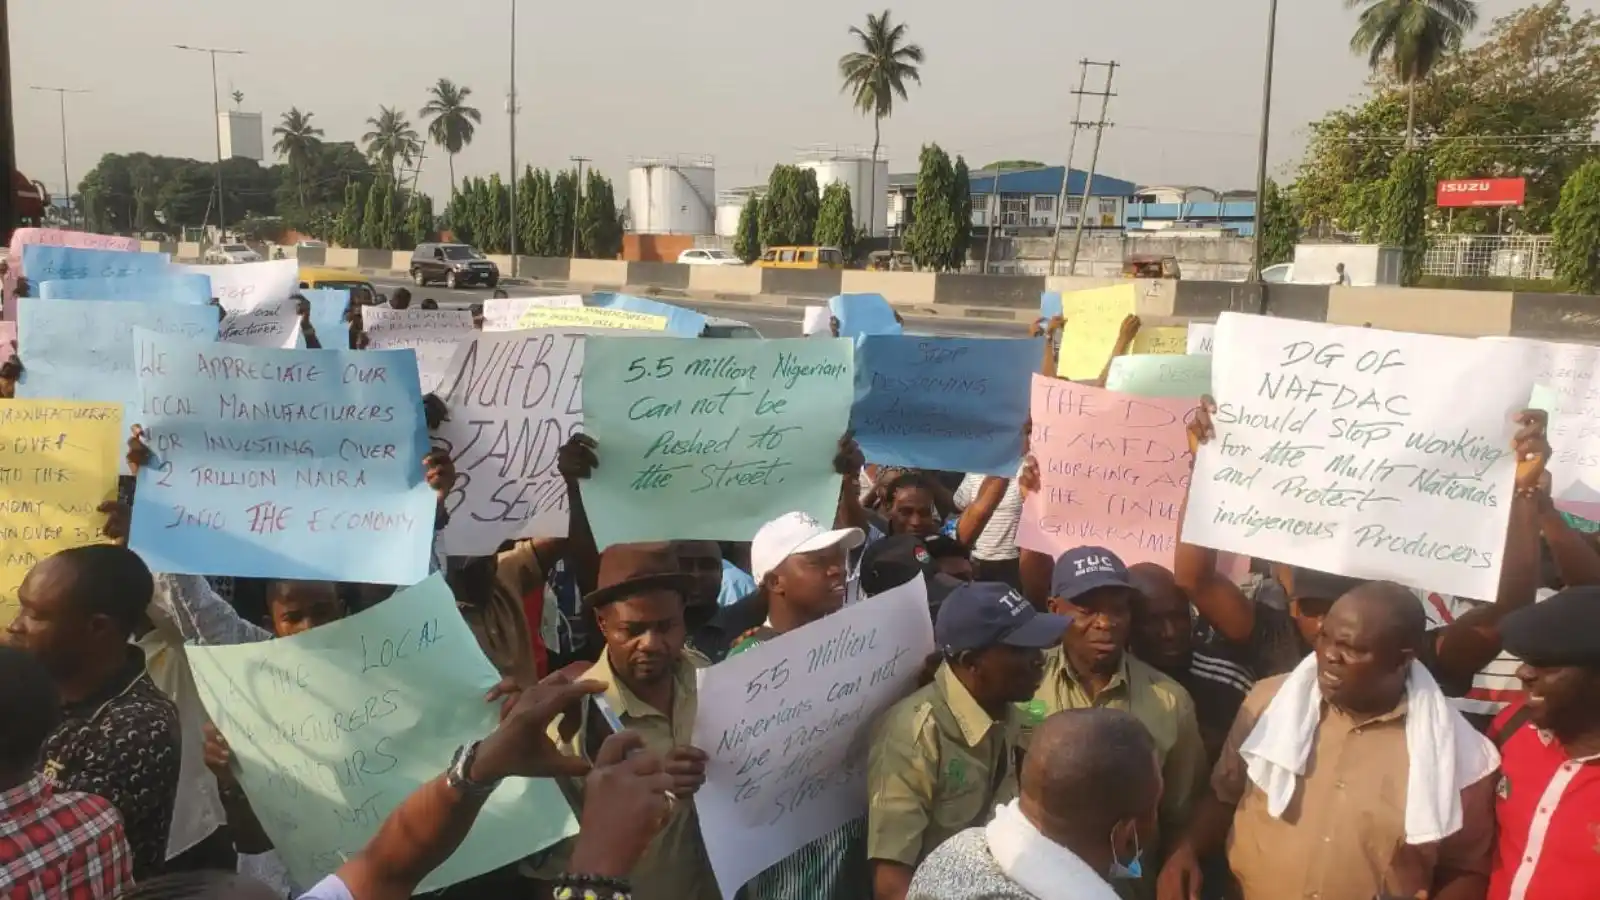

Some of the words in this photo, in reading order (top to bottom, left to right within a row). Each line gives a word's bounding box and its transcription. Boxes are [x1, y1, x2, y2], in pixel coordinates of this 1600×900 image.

[1441, 182, 1490, 192] ISUZU
[140, 341, 167, 379] WE
[342, 363, 387, 385] OUR
[1280, 341, 1346, 368] DG
[624, 356, 675, 383] 5.5
[142, 389, 199, 417] LOCAL
[690, 387, 755, 416] not
[755, 389, 788, 416] be
[1042, 382, 1098, 418] THE
[1257, 372, 1412, 416] NAFDAC
[1216, 402, 1318, 434] Should
[747, 424, 803, 450] to
[1032, 425, 1053, 445] OF
[203, 438, 315, 460] INVESTING
[340, 439, 396, 461] OVER
[1219, 433, 1253, 457] for
[1259, 441, 1326, 469] the
[30, 467, 74, 483] THE
[156, 460, 174, 488] 2
[190, 466, 277, 488] TRILLION
[296, 469, 367, 488] NAIRA
[630, 464, 693, 491] the
[1047, 458, 1141, 487] WORKING
[1212, 466, 1263, 490] and
[1045, 483, 1084, 506] THE
[245, 501, 294, 534] THE
[307, 507, 415, 534] ECONOMY
[1212, 500, 1339, 539] indigenous
[1354, 524, 1493, 570] Producers
[1073, 555, 1113, 570] TUC
[361, 618, 444, 673] LOCAL
[869, 644, 911, 687] not
[745, 657, 790, 704] 5.5
[735, 748, 771, 776] be
[733, 770, 773, 804] to
